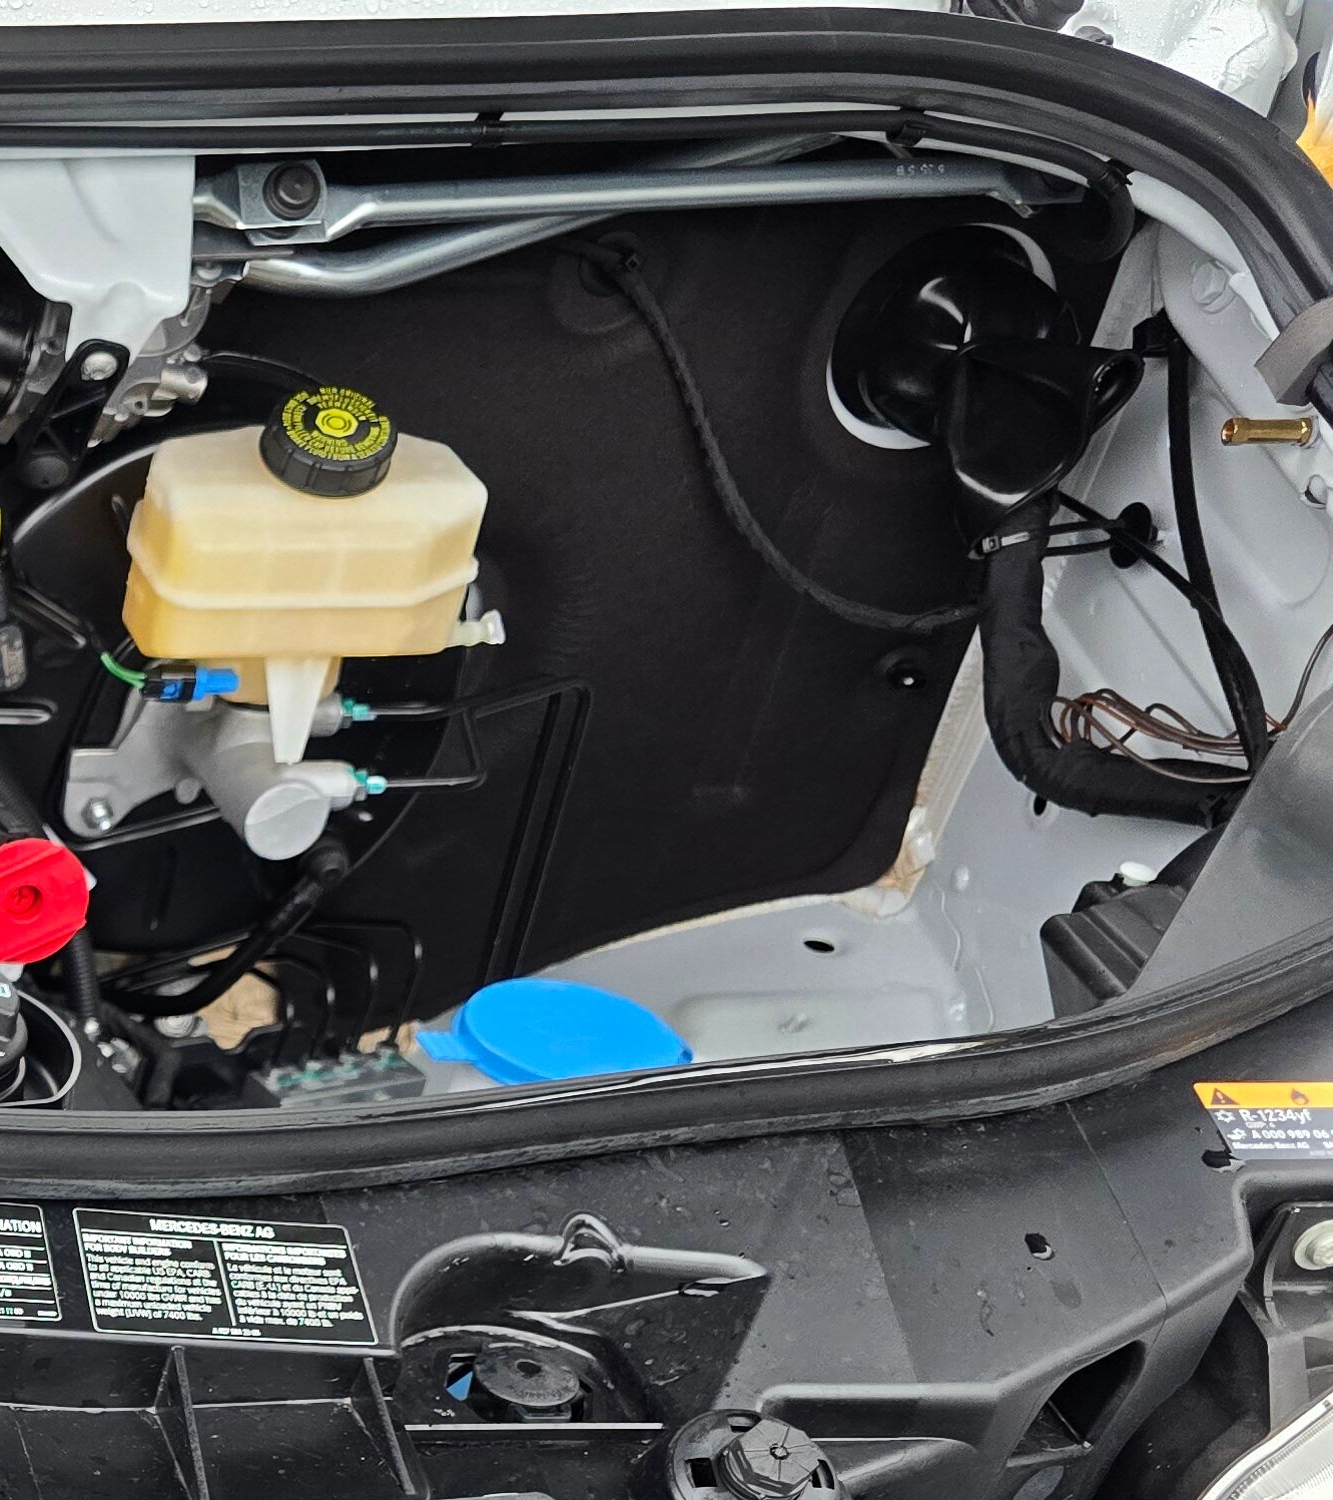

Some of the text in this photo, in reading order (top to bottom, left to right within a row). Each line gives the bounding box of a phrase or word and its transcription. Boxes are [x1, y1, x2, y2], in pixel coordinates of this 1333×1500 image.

[1238, 1109, 1312, 1124] R-1234yf
[1252, 1130, 1261, 1138] A
[150, 1219, 275, 1239] MERCEDES-BENZ AG
[82, 1234, 192, 1249] IMPORTANT INFORMATION
[84, 1243, 103, 1252] FOR
[104, 1244, 127, 1253] BODY
[86, 1254, 104, 1262] This
[105, 1256, 134, 1264] vehicle
[107, 1273, 144, 1282] Canadian
